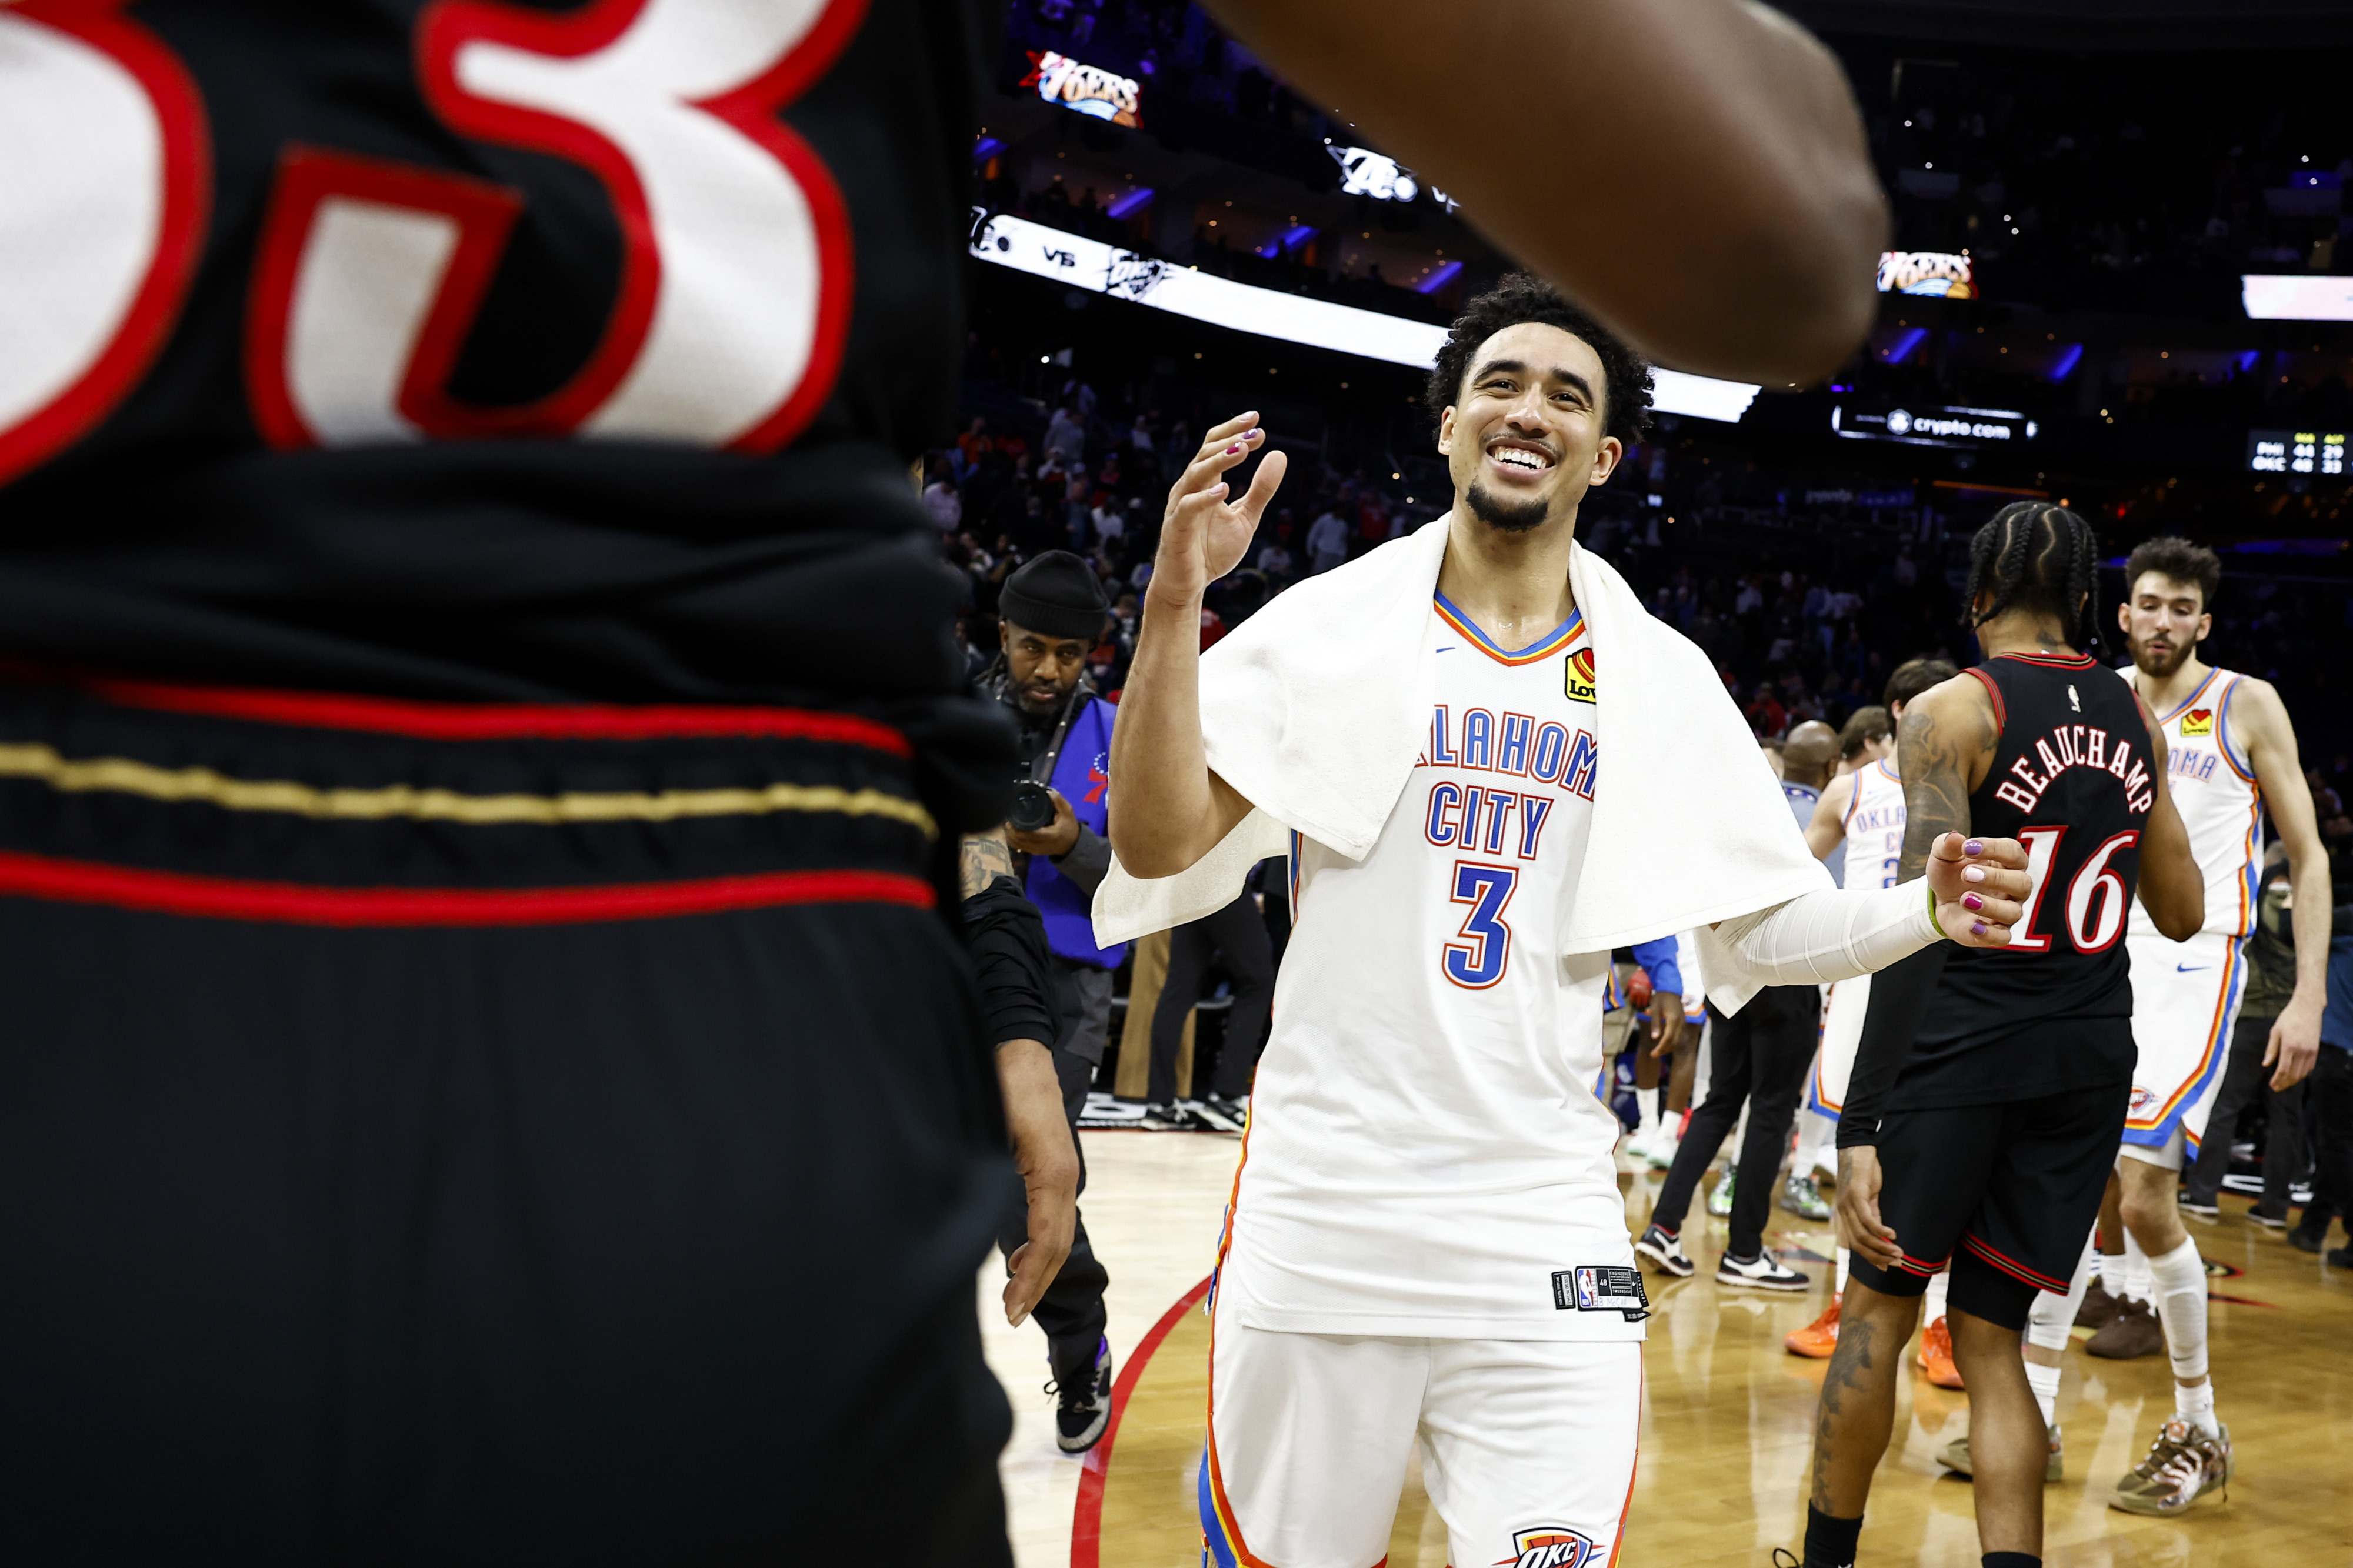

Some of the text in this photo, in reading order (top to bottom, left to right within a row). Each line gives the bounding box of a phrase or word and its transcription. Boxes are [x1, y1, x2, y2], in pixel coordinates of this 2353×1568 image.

[1914, 418, 2011, 440] crypto.com
[2252, 456, 2287, 472] OKC
[1414, 704, 1597, 802] LAHOM
[1994, 724, 2154, 815] BEAUCHAMP
[1425, 781, 1554, 860] CITY
[1442, 860, 1519, 990] 3
[1989, 825, 2140, 954] 16
[1514, 1542, 1577, 1568] OKC
